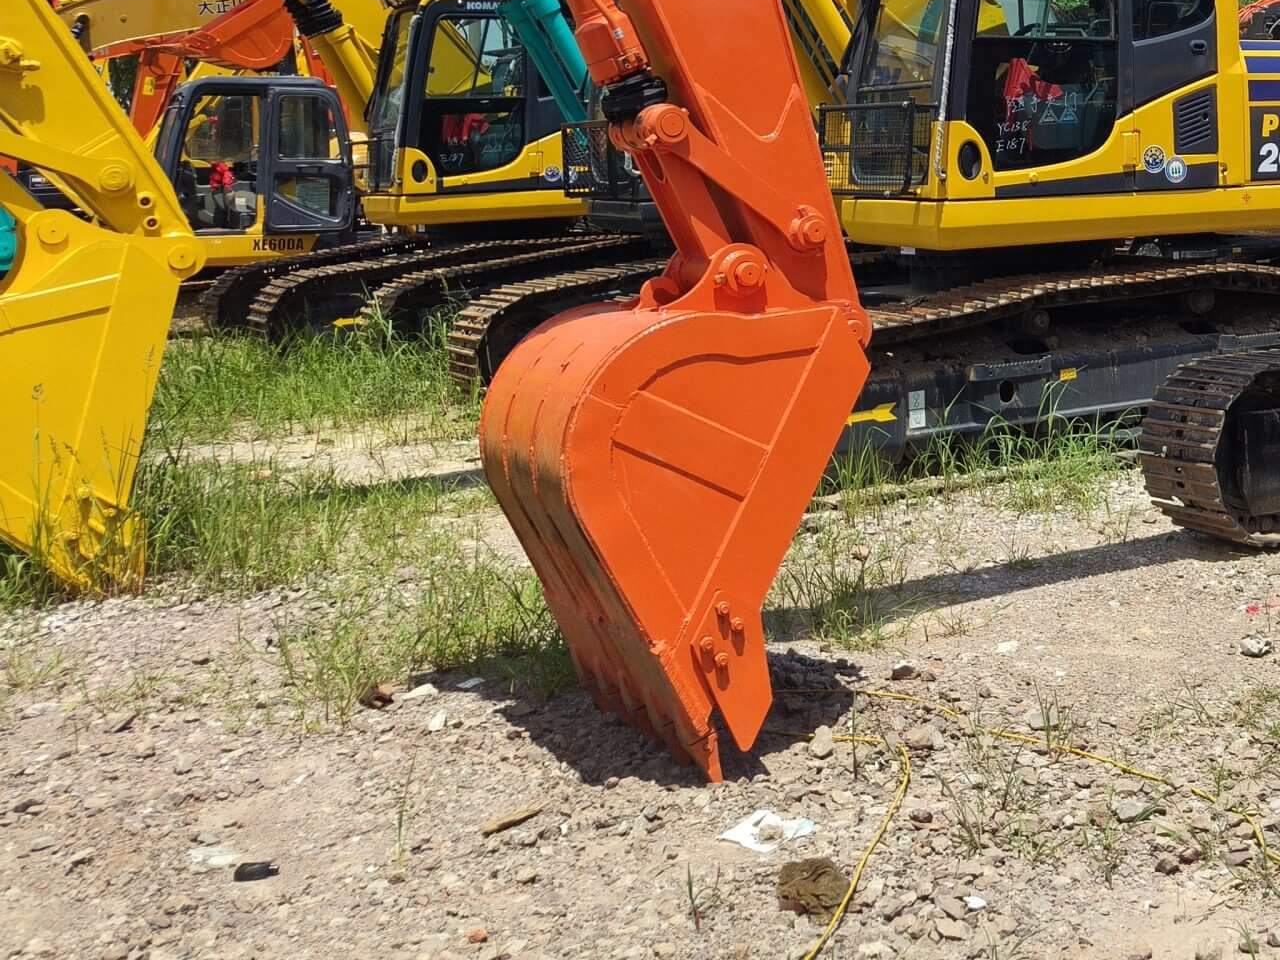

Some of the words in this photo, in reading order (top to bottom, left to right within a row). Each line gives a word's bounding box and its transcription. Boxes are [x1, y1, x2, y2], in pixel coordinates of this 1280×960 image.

[466, 1, 499, 10] KOMA
[997, 120, 1032, 136] YC138
[994, 137, 1026, 155] E187
[252, 238, 304, 251] XE60DA
